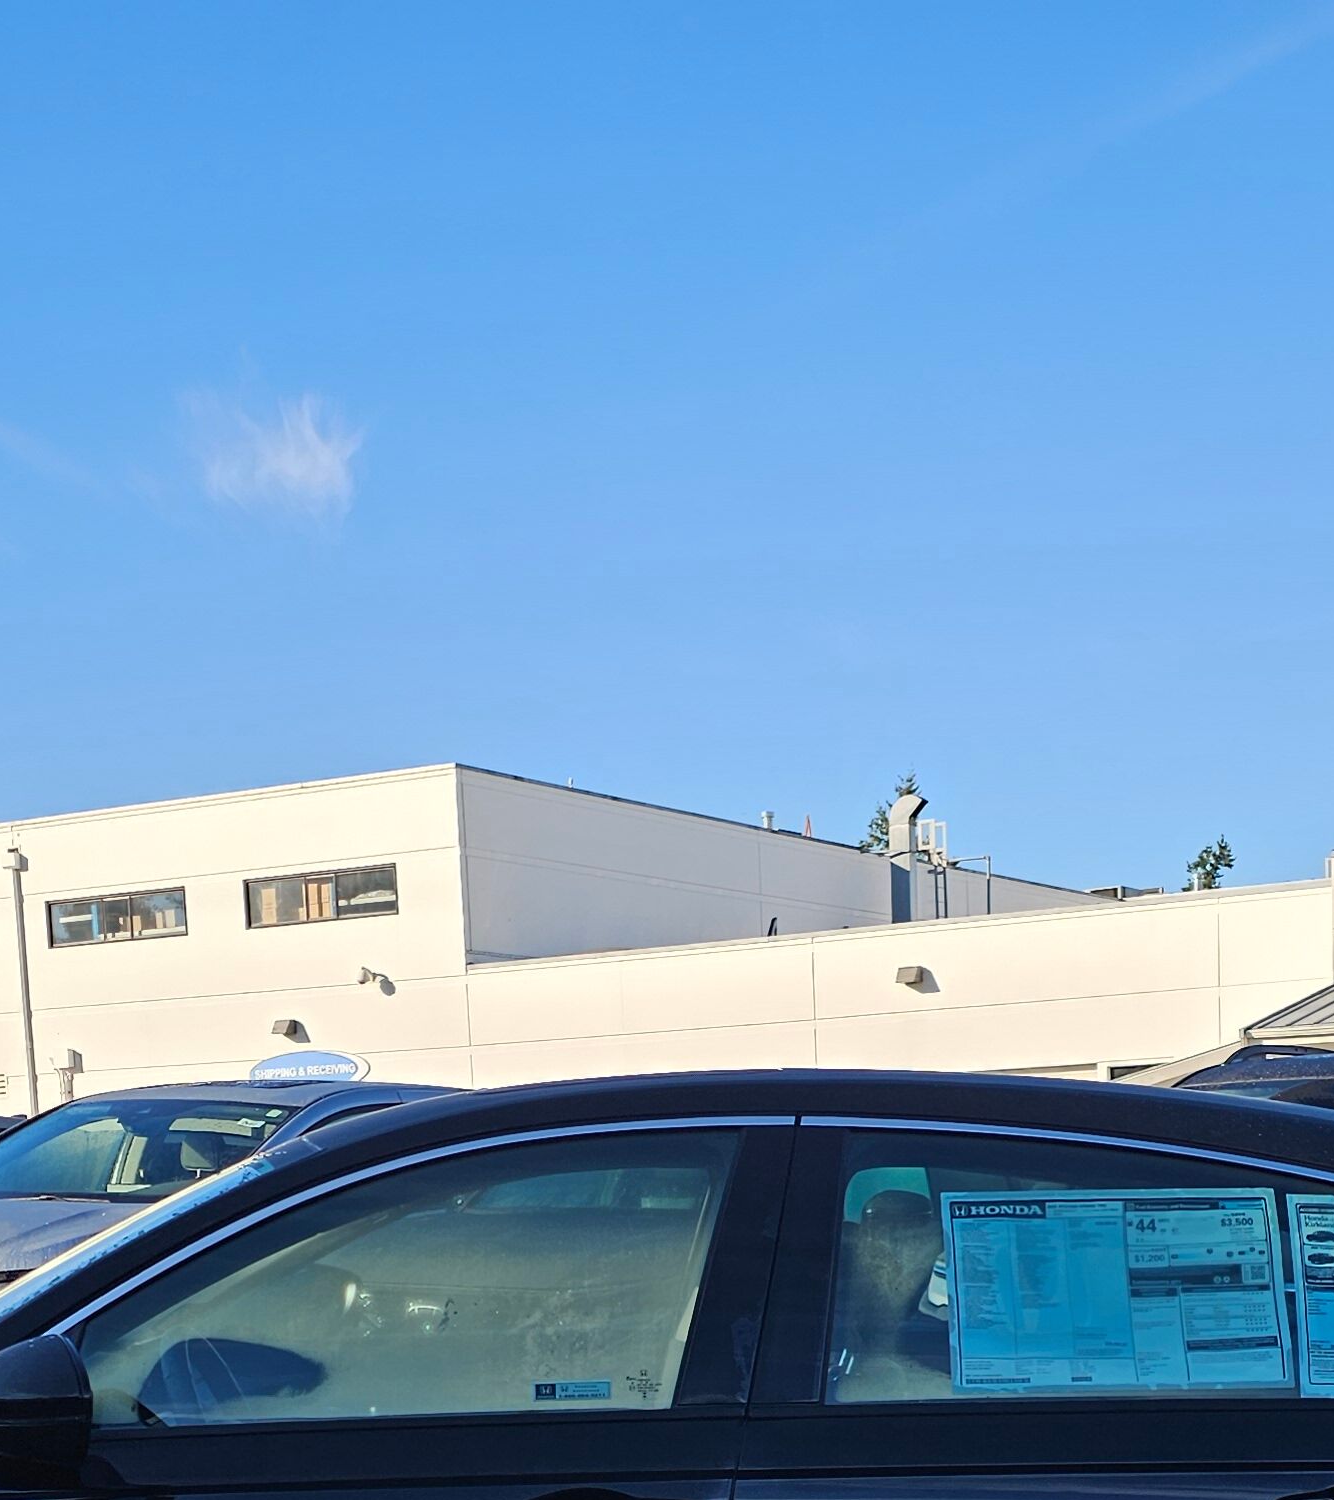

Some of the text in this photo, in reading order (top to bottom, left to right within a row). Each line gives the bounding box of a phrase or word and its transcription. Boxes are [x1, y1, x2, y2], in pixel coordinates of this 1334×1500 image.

[254, 1062, 356, 1080] SHIPPING & RECEIVING
[970, 1205, 1043, 1215] HONDA
[1135, 1218, 1157, 1233] 44
[1221, 1217, 1254, 1227] $3,500
[1134, 1254, 1165, 1263] $1,200
